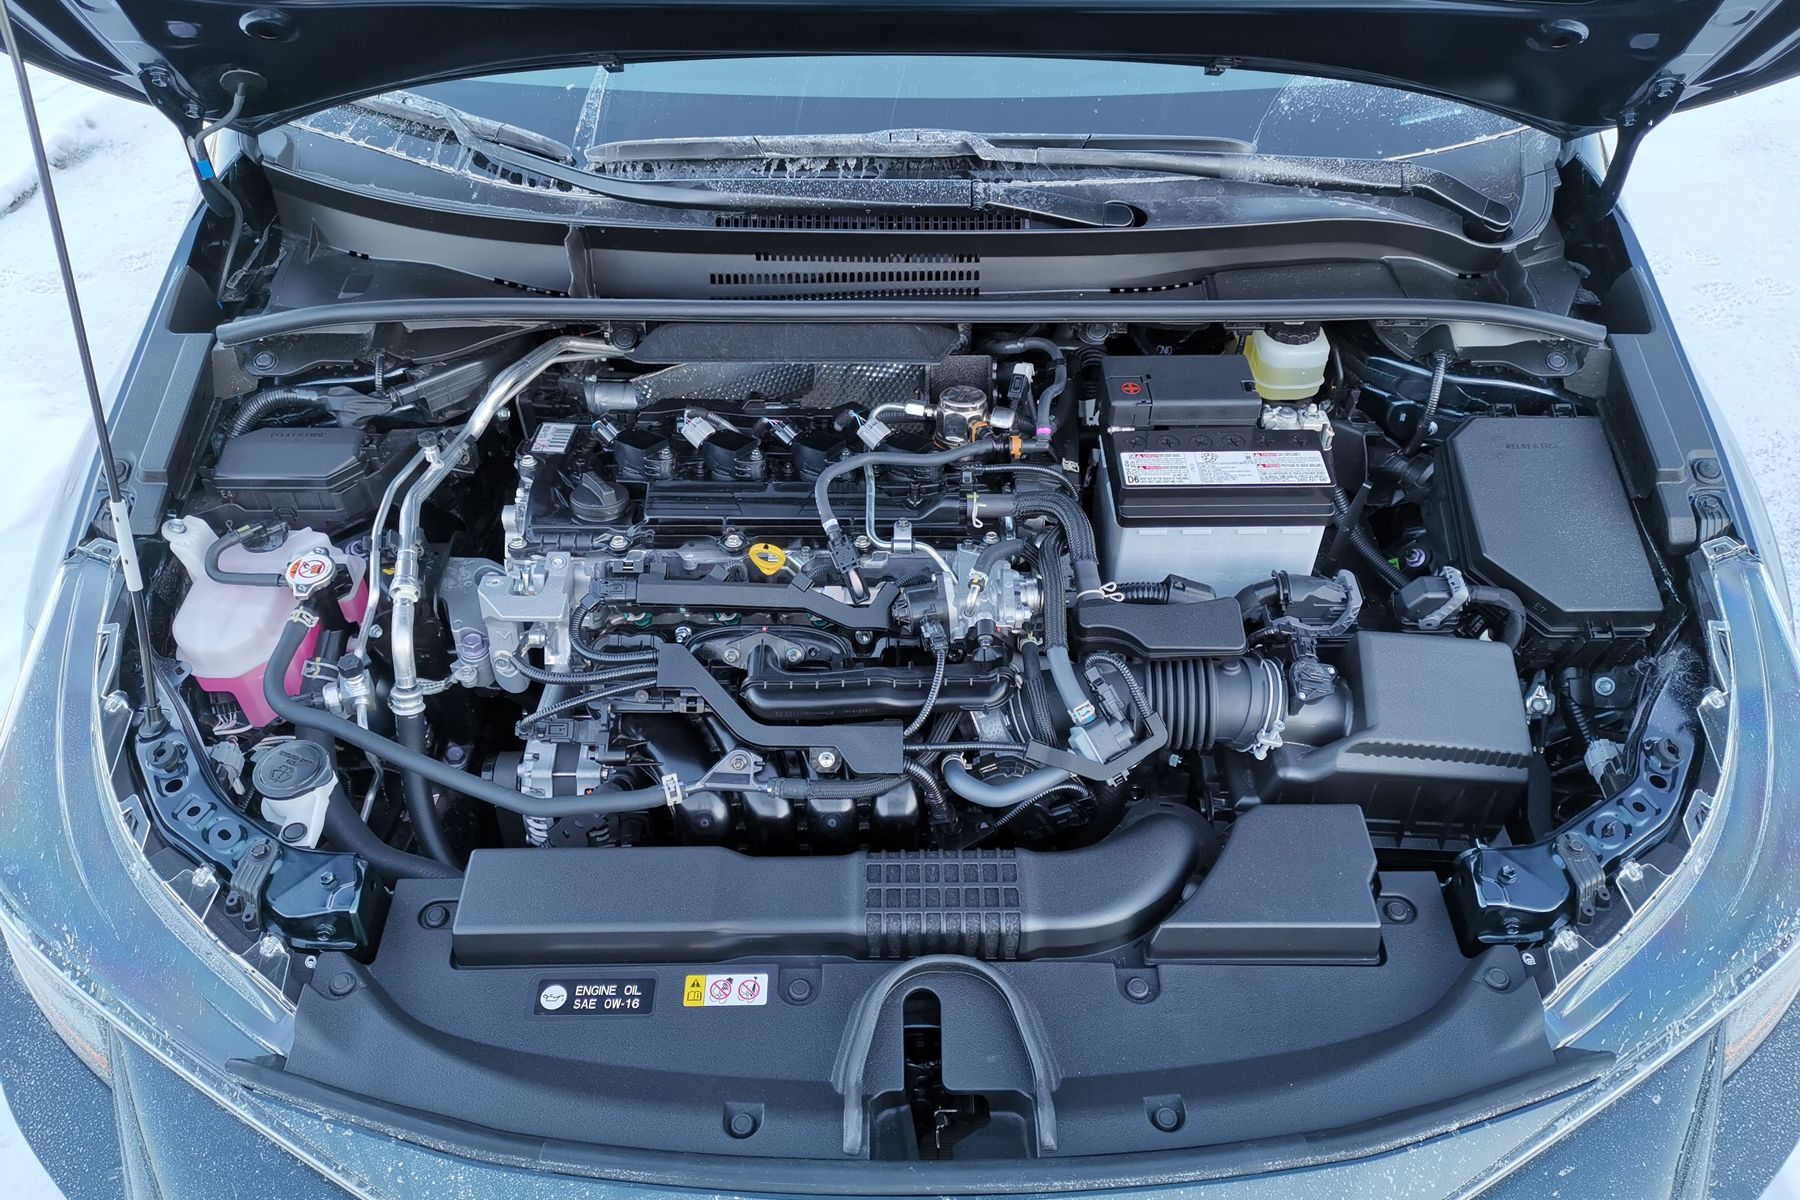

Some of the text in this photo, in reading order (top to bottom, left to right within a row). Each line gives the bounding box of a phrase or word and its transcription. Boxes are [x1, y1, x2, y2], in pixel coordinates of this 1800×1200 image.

[1127, 475, 1140, 484] D6
[574, 985, 642, 996] ENGINE OIL
[573, 999, 640, 1009] SAE 0W-16
